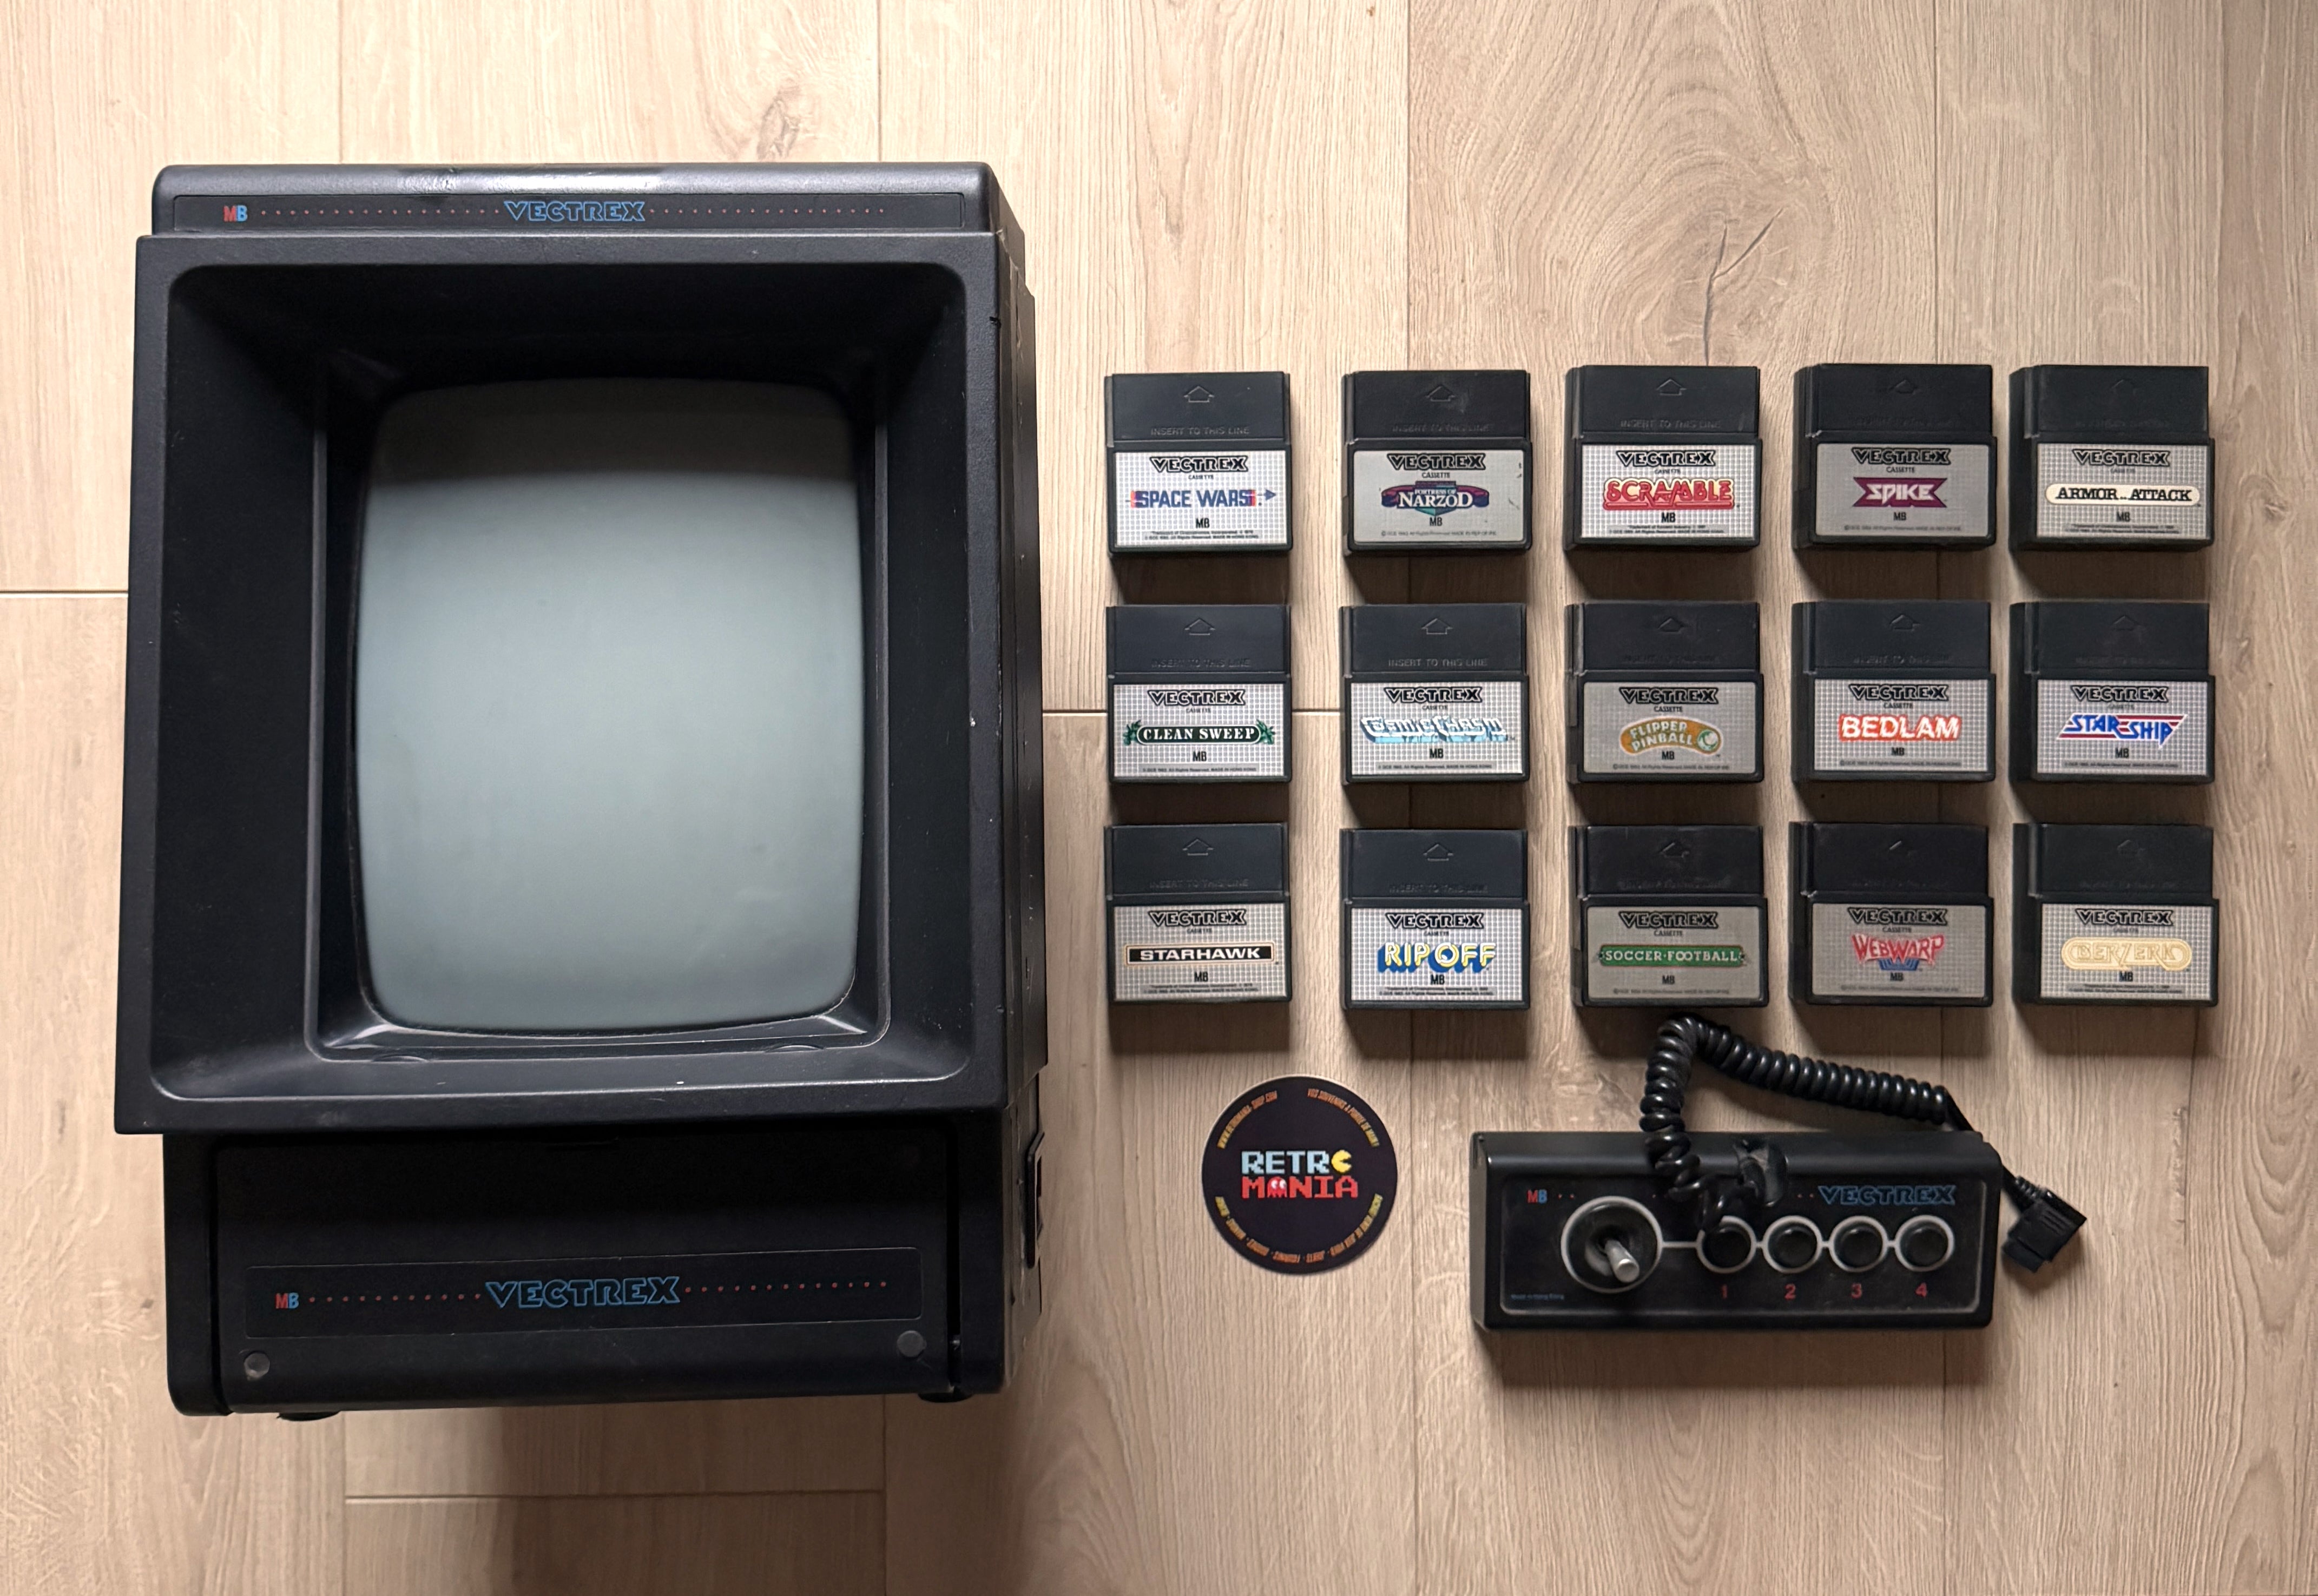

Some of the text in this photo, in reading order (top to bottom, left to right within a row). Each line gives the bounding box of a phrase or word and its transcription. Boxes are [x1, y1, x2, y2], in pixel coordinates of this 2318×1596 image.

[223, 206, 248, 221] MB
[503, 201, 645, 221] VECTREX
[1387, 453, 1486, 470] VECTREX
[1616, 450, 1715, 467] VECTREX
[1852, 447, 1951, 465] VECTREX
[2072, 449, 2170, 467] VECTREX
[1150, 456, 1248, 472] VECTREX
[1134, 490, 1250, 507] SPACE WARS
[1399, 492, 1473, 507] NARZOD
[1605, 479, 1733, 507] SCRAMBLE
[1866, 484, 1935, 505] SPIKE
[1196, 518, 1209, 528] MB
[1430, 517, 1442, 526] MB
[1662, 513, 1675, 523] MB
[1894, 512, 1906, 520] MB
[2117, 512, 2130, 522] MB
[1148, 689, 1246, 706] VECTREX
[1384, 687, 1483, 703] VECTREX
[1619, 687, 1718, 704] VECTREX
[1848, 683, 1949, 701] VECTREX
[2071, 685, 2169, 702] VECTREX
[1143, 728, 1255, 740] CLEAN SWEEP
[1630, 721, 1687, 738] FLIPPER
[1840, 715, 1961, 740] BEDLAM
[1631, 733, 1693, 751] PINBALL
[1193, 751, 1207, 761] MB
[1430, 749, 1444, 759] MB
[1662, 751, 1674, 760] MB
[1892, 748, 1905, 756] MB
[2115, 749, 2129, 757] MB
[1148, 909, 1247, 927] VECTREX
[1385, 912, 1484, 929] VECTREX
[1619, 911, 1718, 928] VECTREX
[1848, 907, 1947, 926] VECTREX
[2075, 908, 2174, 926] VECTREX
[1140, 948, 1260, 960] STARHAWK
[2070, 940, 2185, 967] BERZERK
[1195, 972, 1208, 982] MB
[1431, 974, 1445, 985] MB
[1662, 975, 1675, 985] MB
[1890, 973, 1903, 981] MB
[2119, 972, 2133, 981] MB
[1527, 1190, 1547, 1203] MB
[1817, 1185, 1955, 1204] VECTREX
[486, 1276, 680, 1308] VECTREX
[1722, 1285, 1727, 1297] 1
[1785, 1284, 1796, 1299] 2
[1851, 1283, 1862, 1298] 3
[1915, 1283, 1927, 1297] 4
[276, 1294, 299, 1309] MB
